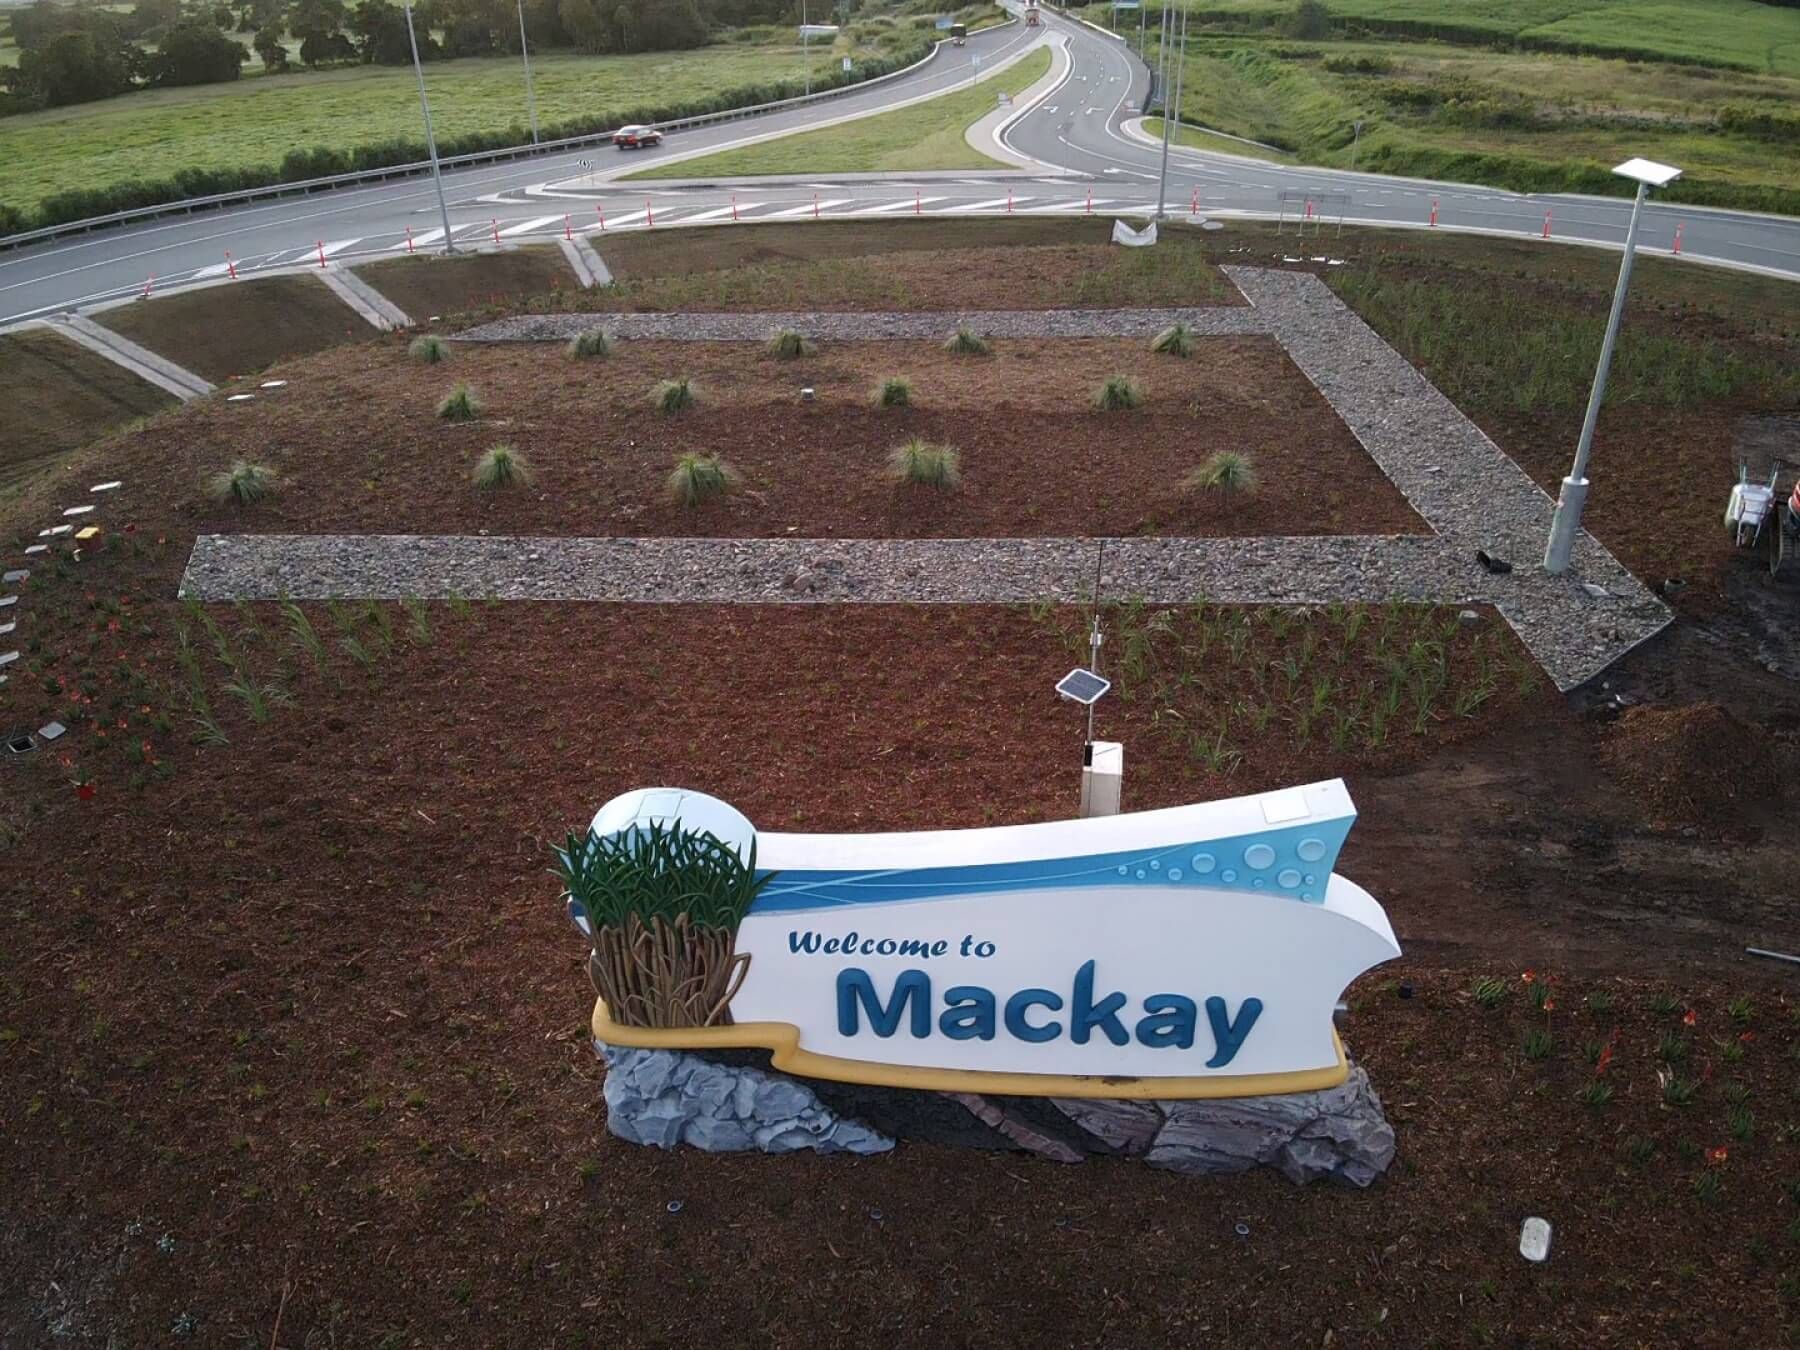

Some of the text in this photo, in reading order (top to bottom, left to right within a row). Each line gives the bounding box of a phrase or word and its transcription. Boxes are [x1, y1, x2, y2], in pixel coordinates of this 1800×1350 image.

[788, 931, 996, 959] Welcome to
[835, 959, 1264, 1069] Mackay
